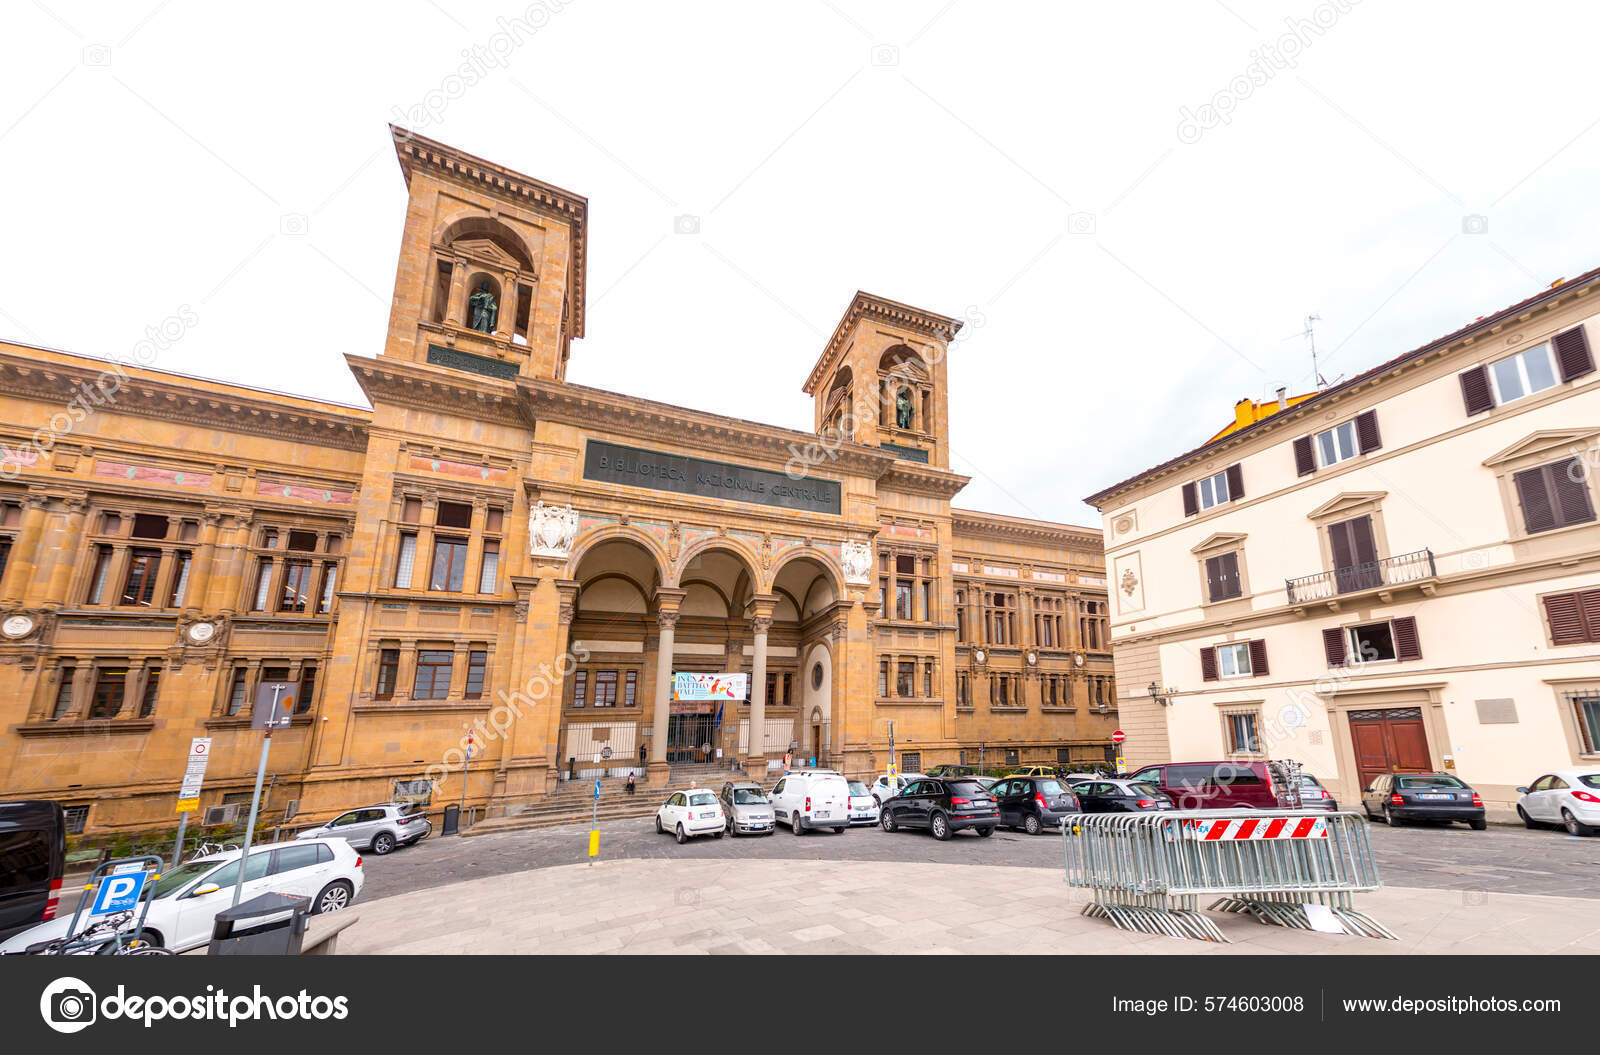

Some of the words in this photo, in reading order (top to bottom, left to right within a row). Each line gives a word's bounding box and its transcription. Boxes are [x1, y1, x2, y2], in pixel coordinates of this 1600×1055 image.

[600, 456, 687, 481] BIBLIOTECA
[697, 473, 765, 493] NAZIONALE
[771, 485, 832, 503] CENTRALE
[101, 877, 136, 910] P
